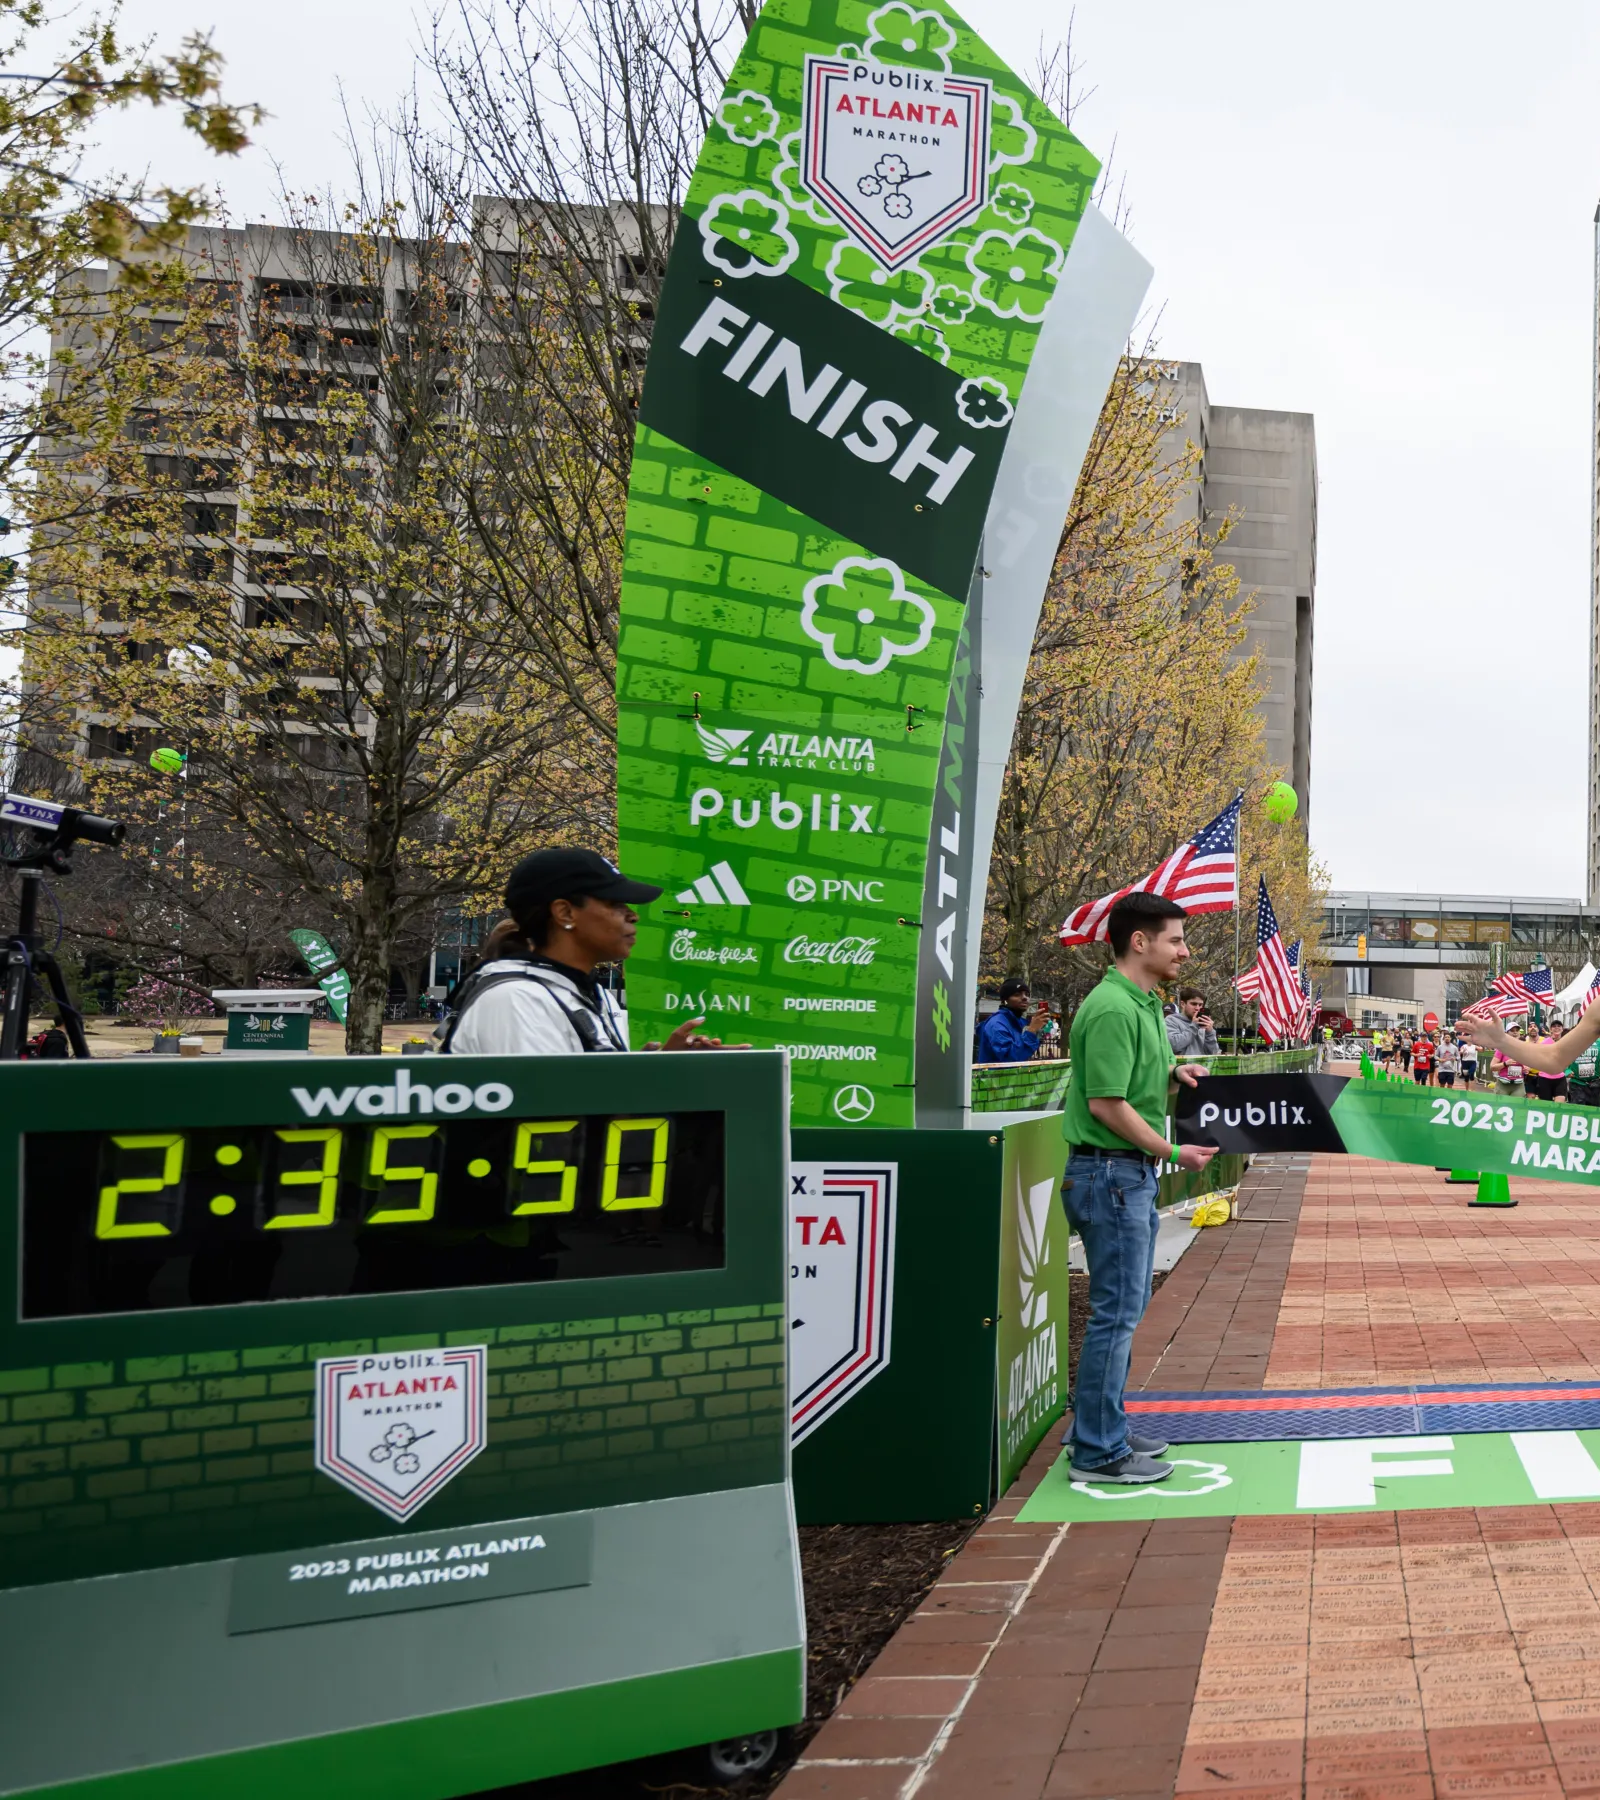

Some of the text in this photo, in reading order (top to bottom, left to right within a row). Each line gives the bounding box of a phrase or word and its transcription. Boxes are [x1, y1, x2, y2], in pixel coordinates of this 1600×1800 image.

[853, 66, 934, 93] Publix
[835, 94, 959, 128] ATLANTA
[853, 127, 941, 146] MARATHON
[679, 296, 975, 505] FINISH
[758, 733, 876, 761] ATLANTA
[758, 756, 875, 773] TRACK CLUB
[20, 804, 55, 820] LYNX
[690, 787, 874, 833] Publix
[821, 879, 884, 902] PNC
[784, 934, 881, 965] Coca-Cola
[665, 989, 751, 1016] DASANI
[784, 997, 877, 1013] POWERADE
[291, 1069, 514, 1117] wahoo
[1200, 1100, 1305, 1128] Publix
[1430, 1098, 1514, 1133] 2023
[361, 1352, 438, 1375] Publix
[1008, 1321, 1057, 1430] ATLANTA
[347, 1374, 458, 1401] ATLANTA
[363, 1401, 443, 1417] MARATHON
[1033, 1382, 1057, 1424] CLUB
[289, 1533, 547, 1583] 2023 PUBLIX ATLANTA
[347, 1561, 490, 1595] MARATHON
